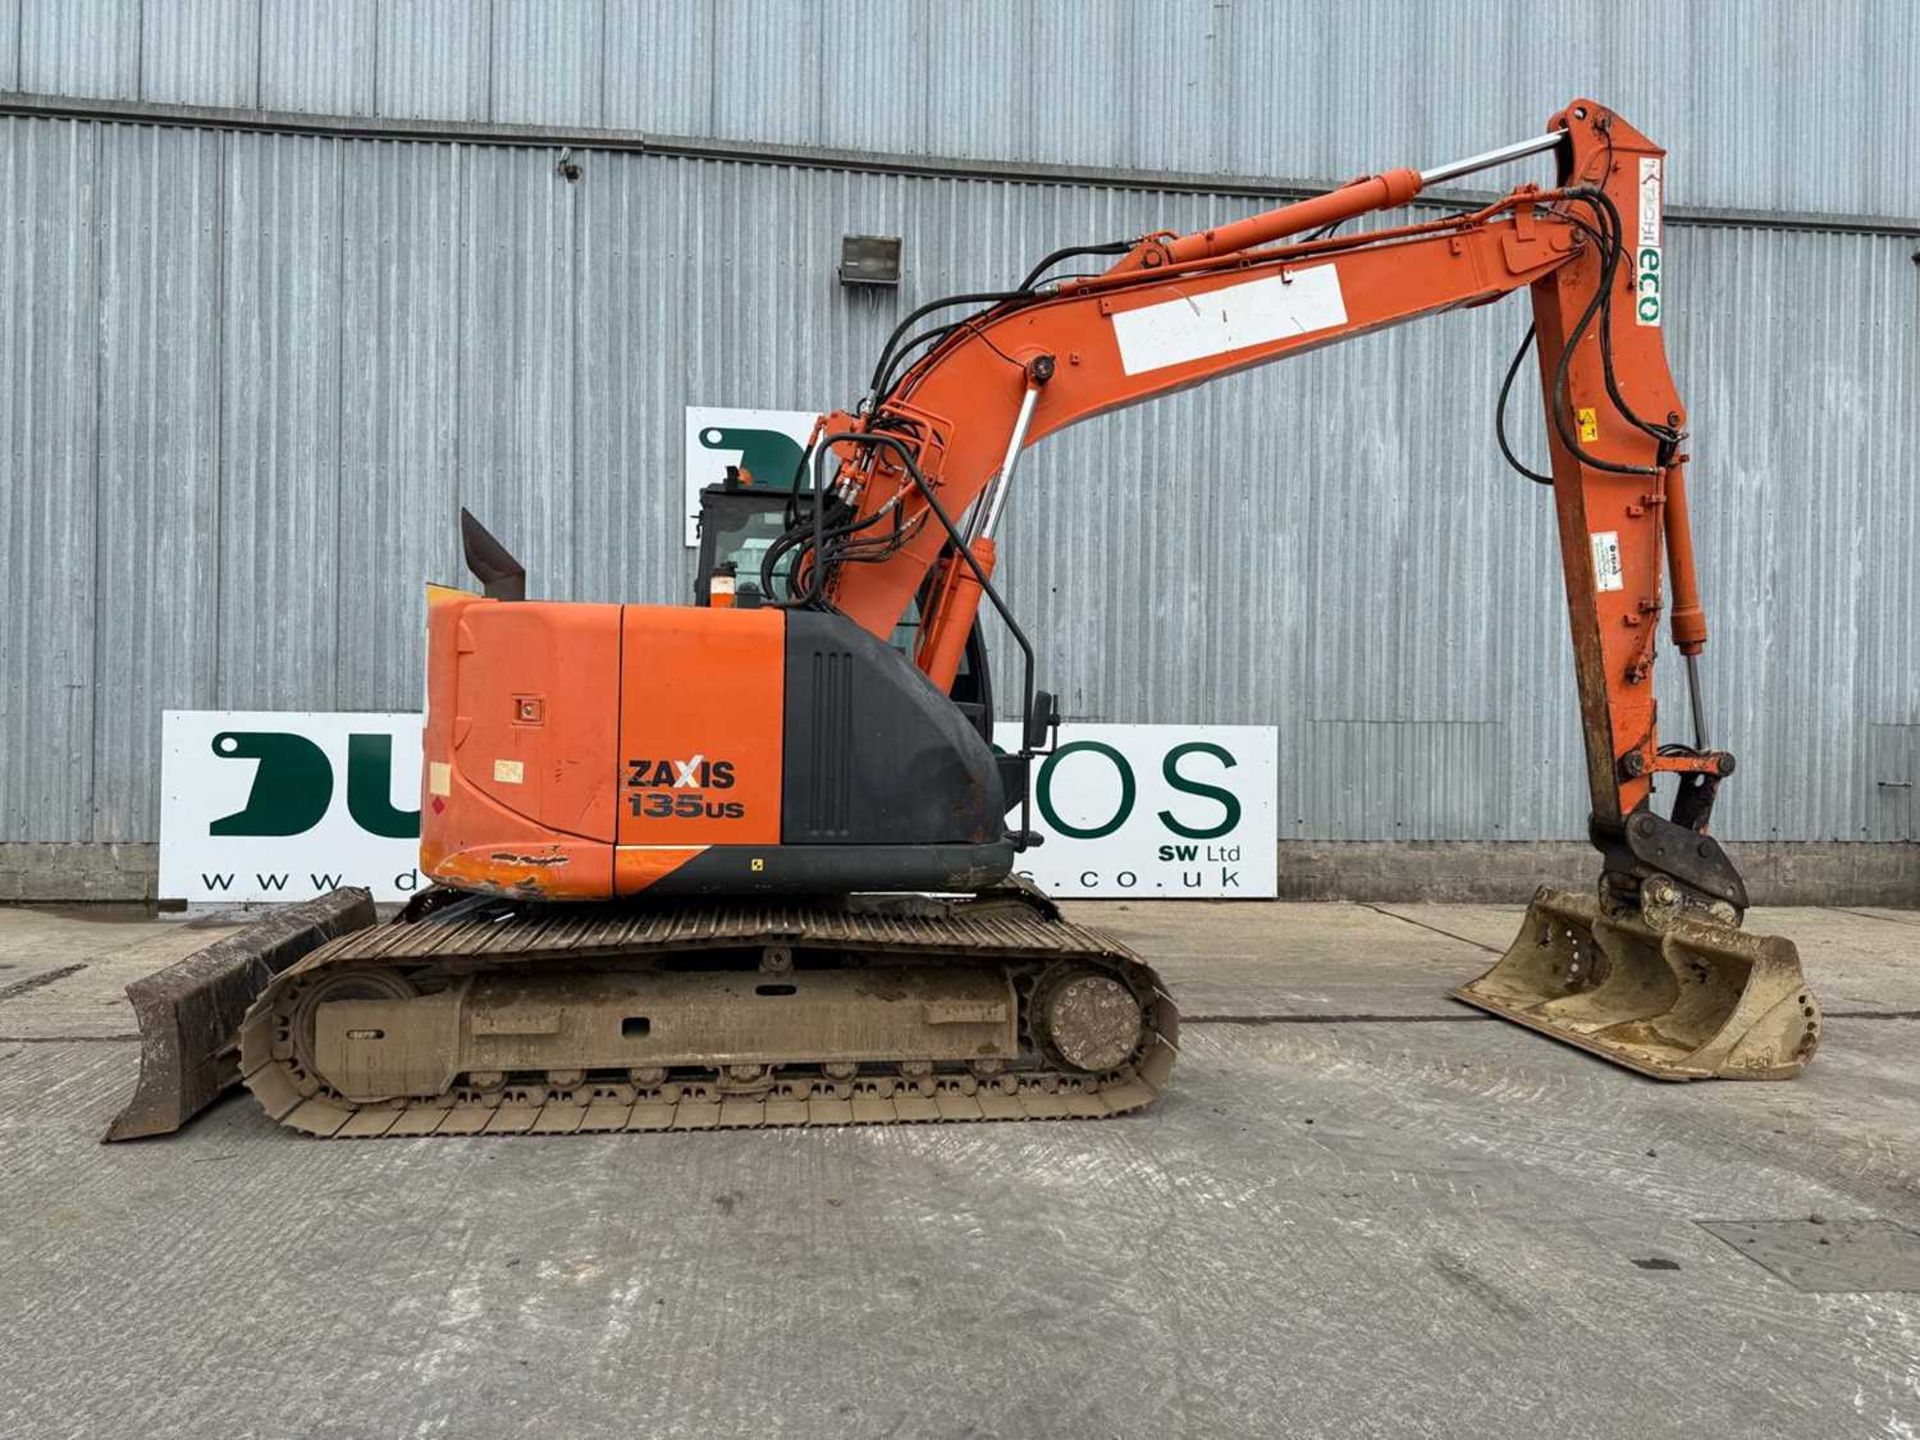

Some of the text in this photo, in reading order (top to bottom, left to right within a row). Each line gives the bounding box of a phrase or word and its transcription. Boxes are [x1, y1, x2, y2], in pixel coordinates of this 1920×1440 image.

[1638, 248, 1660, 321] eco
[628, 754, 735, 789] ZAXIS
[1207, 845, 1241, 862] Ltd
